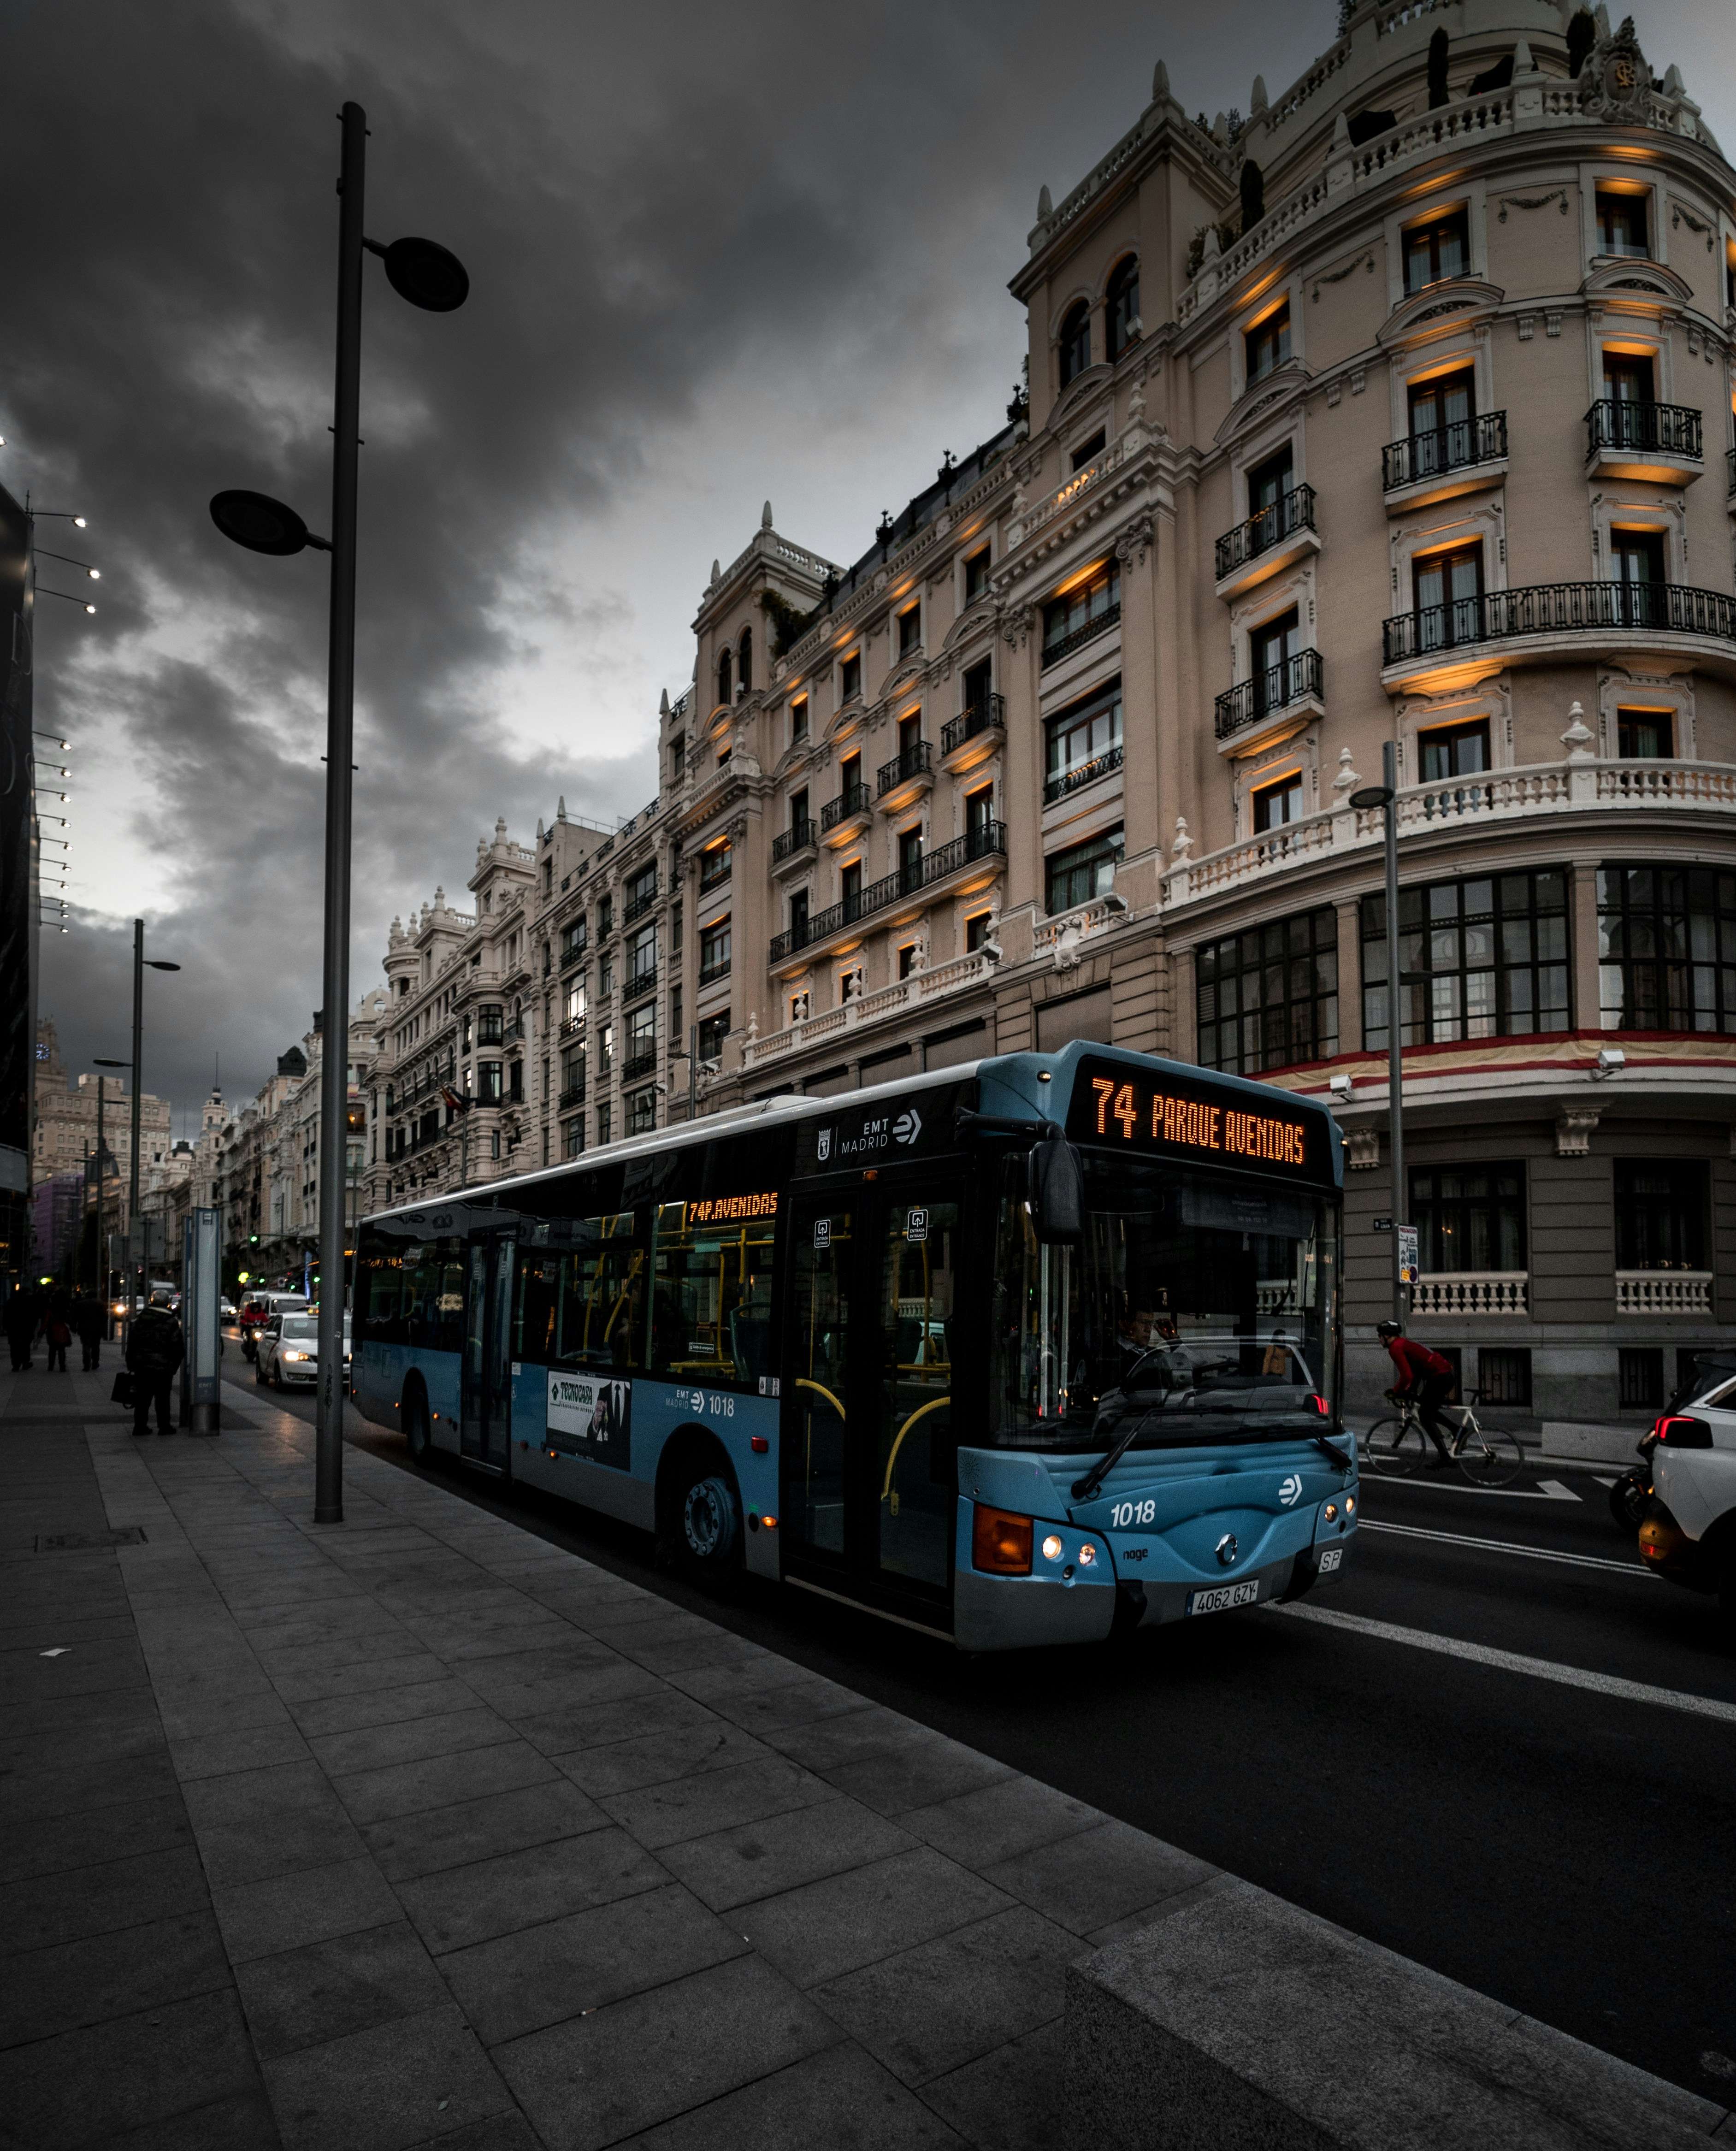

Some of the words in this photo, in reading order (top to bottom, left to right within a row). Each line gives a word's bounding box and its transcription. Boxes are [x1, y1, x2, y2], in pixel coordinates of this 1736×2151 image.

[863, 1118, 889, 1135] EMT
[1092, 1077, 1136, 1138] 74
[1153, 1095, 1219, 1148] PARQUE
[1225, 1111, 1304, 1164] AVENIDAS
[841, 1134, 887, 1154] MADRID
[561, 1382, 593, 1405] TECNOCASA
[676, 1390, 689, 1399] EMT
[666, 1398, 689, 1410] MADRID
[709, 1395, 735, 1418] 1018
[1111, 1499, 1156, 1527] 1018
[1122, 1548, 1148, 1561] noge
[1323, 1552, 1340, 1570] SP
[1198, 1590, 1230, 1611] 4062
[1234, 1583, 1256, 1604] GZY
